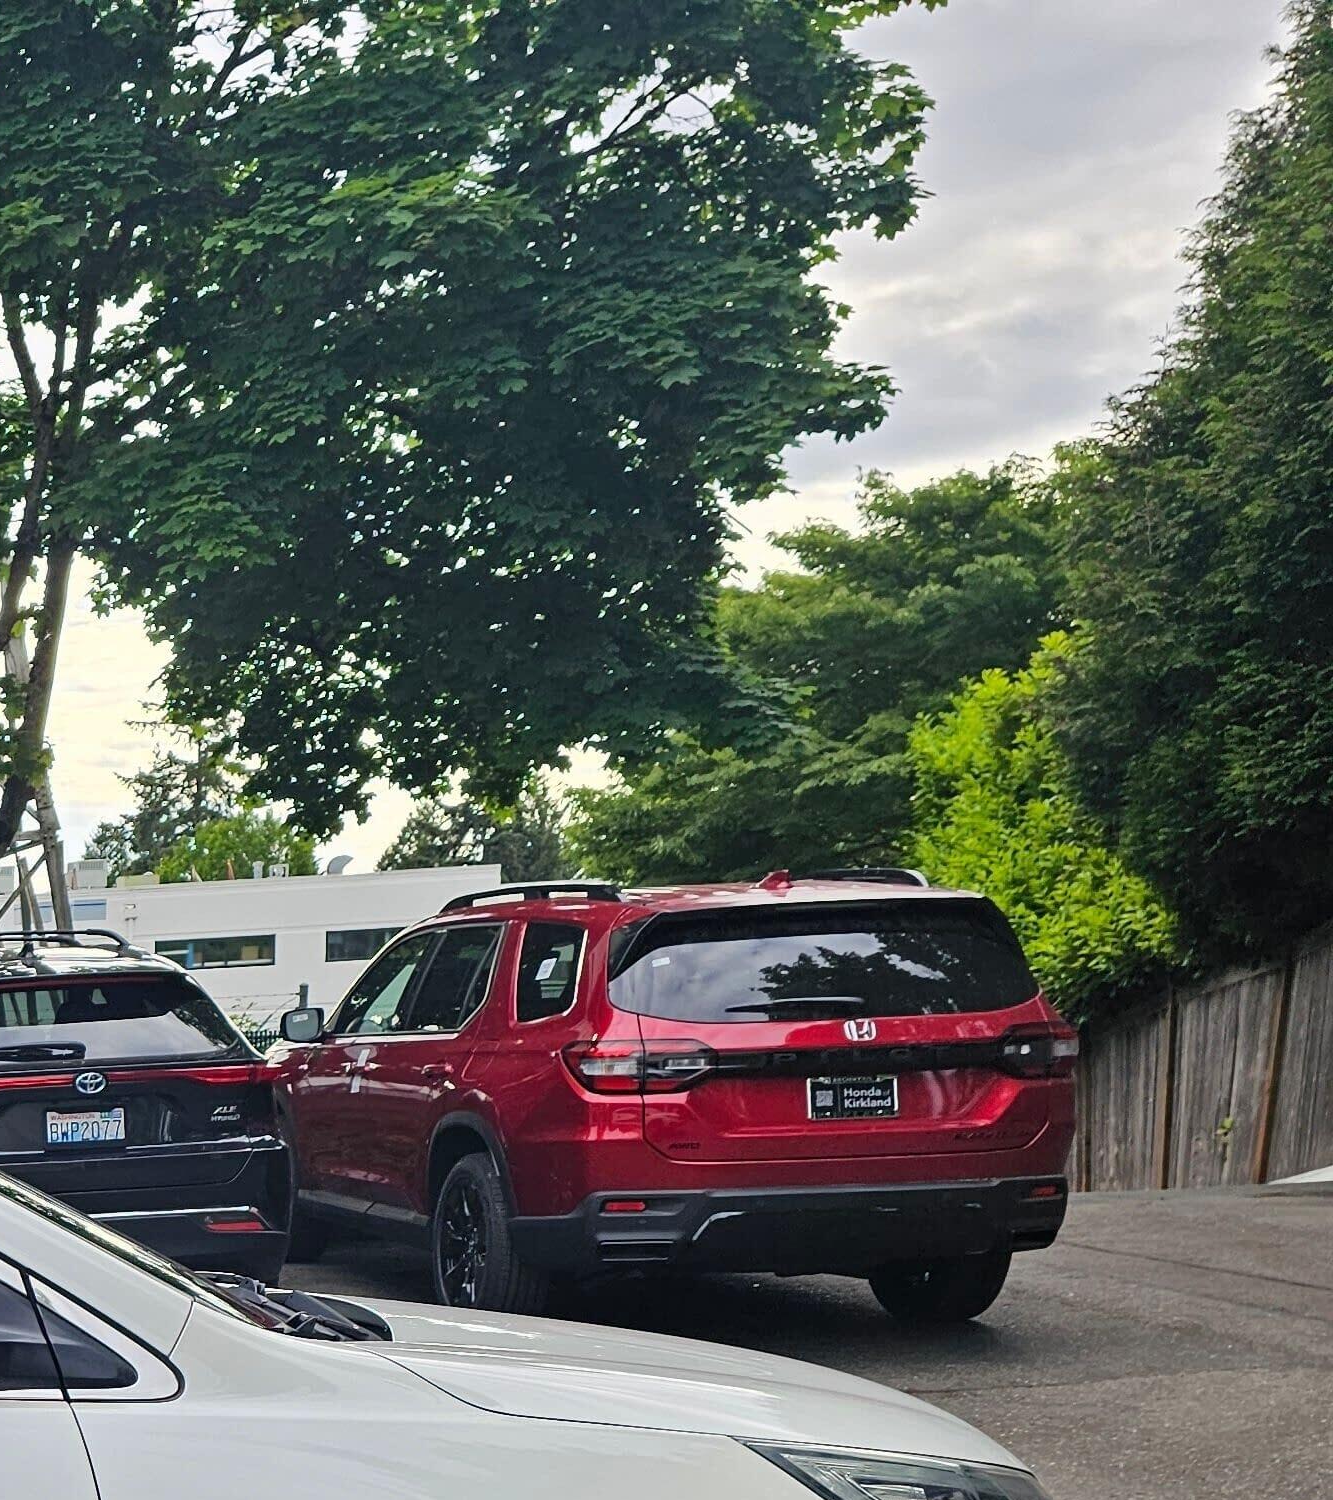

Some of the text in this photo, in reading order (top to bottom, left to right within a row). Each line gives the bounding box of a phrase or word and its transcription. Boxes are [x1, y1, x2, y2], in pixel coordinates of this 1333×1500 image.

[844, 1087, 882, 1097] Honda
[844, 1096, 891, 1108] Kirkland
[50, 1120, 121, 1142] BWP2077
